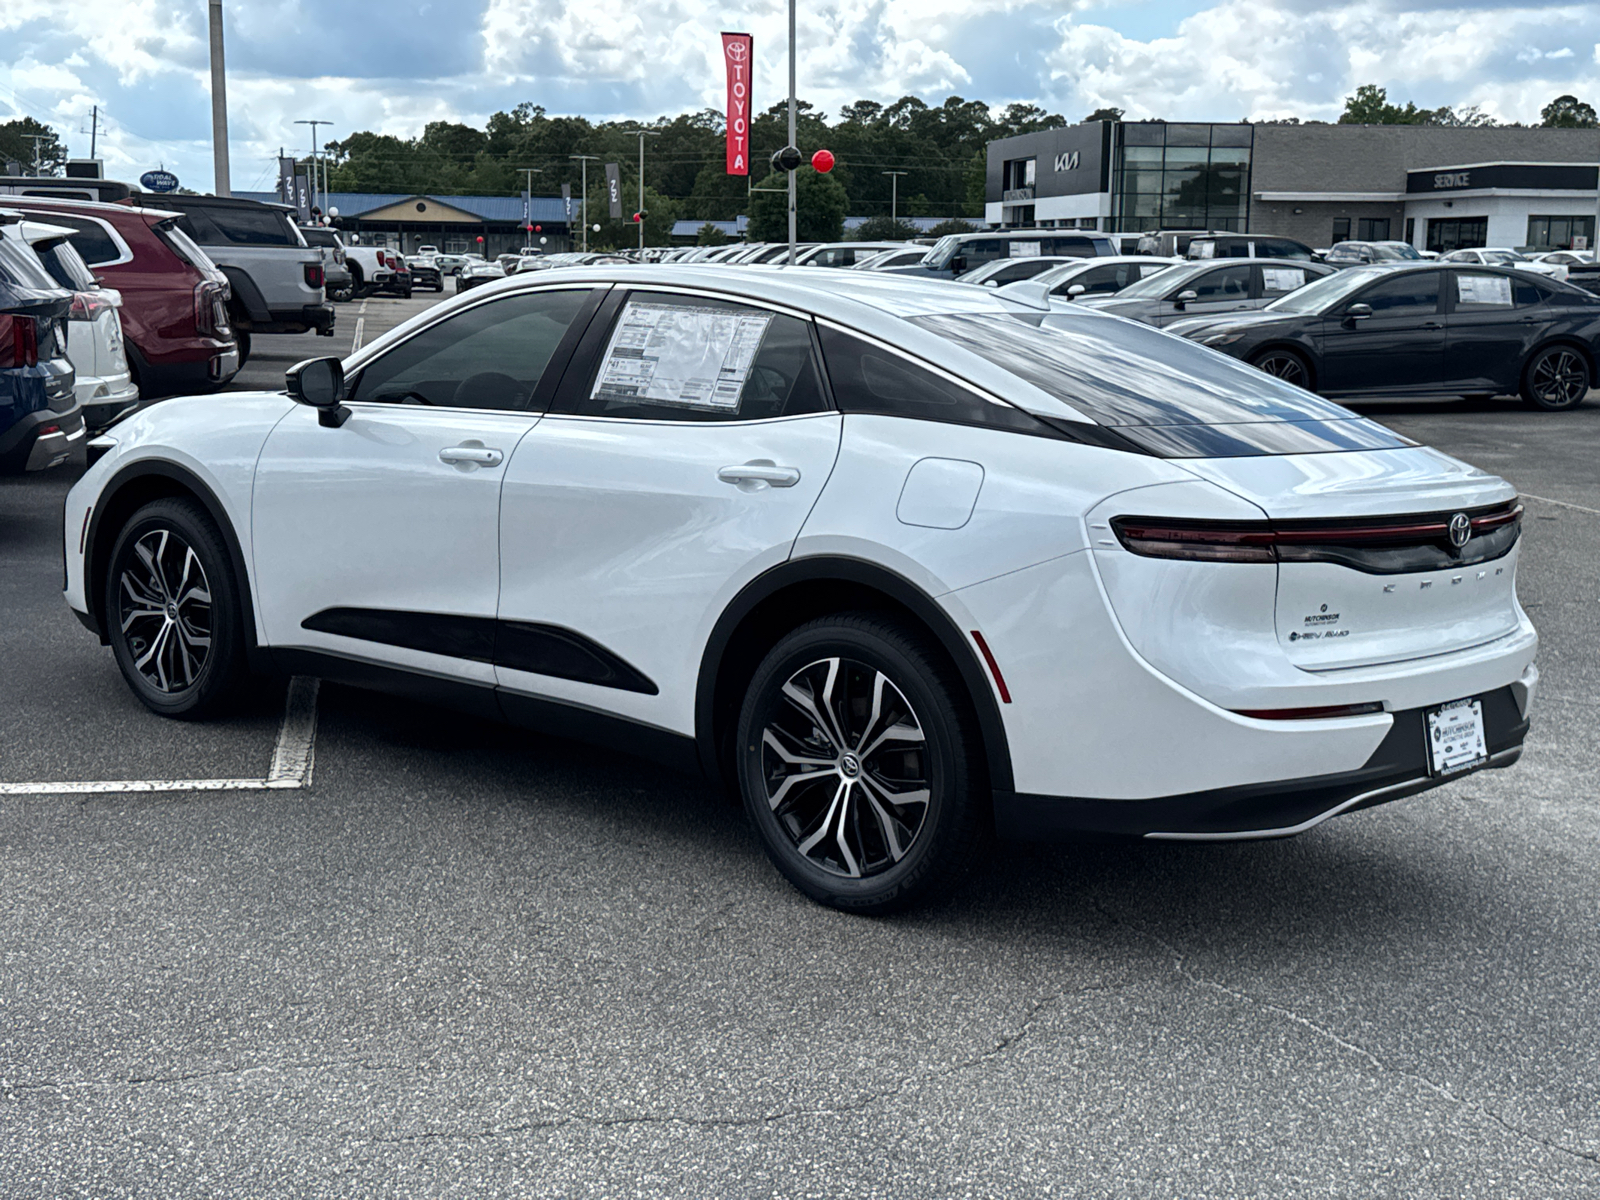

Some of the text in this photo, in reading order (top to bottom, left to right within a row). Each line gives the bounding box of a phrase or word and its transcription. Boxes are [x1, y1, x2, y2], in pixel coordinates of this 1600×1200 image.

[733, 65, 745, 169] TOYOTA
[1054, 151, 1079, 172] KIA
[1434, 172, 1470, 188] SERVICE
[1442, 720, 1476, 737] HUTCHINSON
